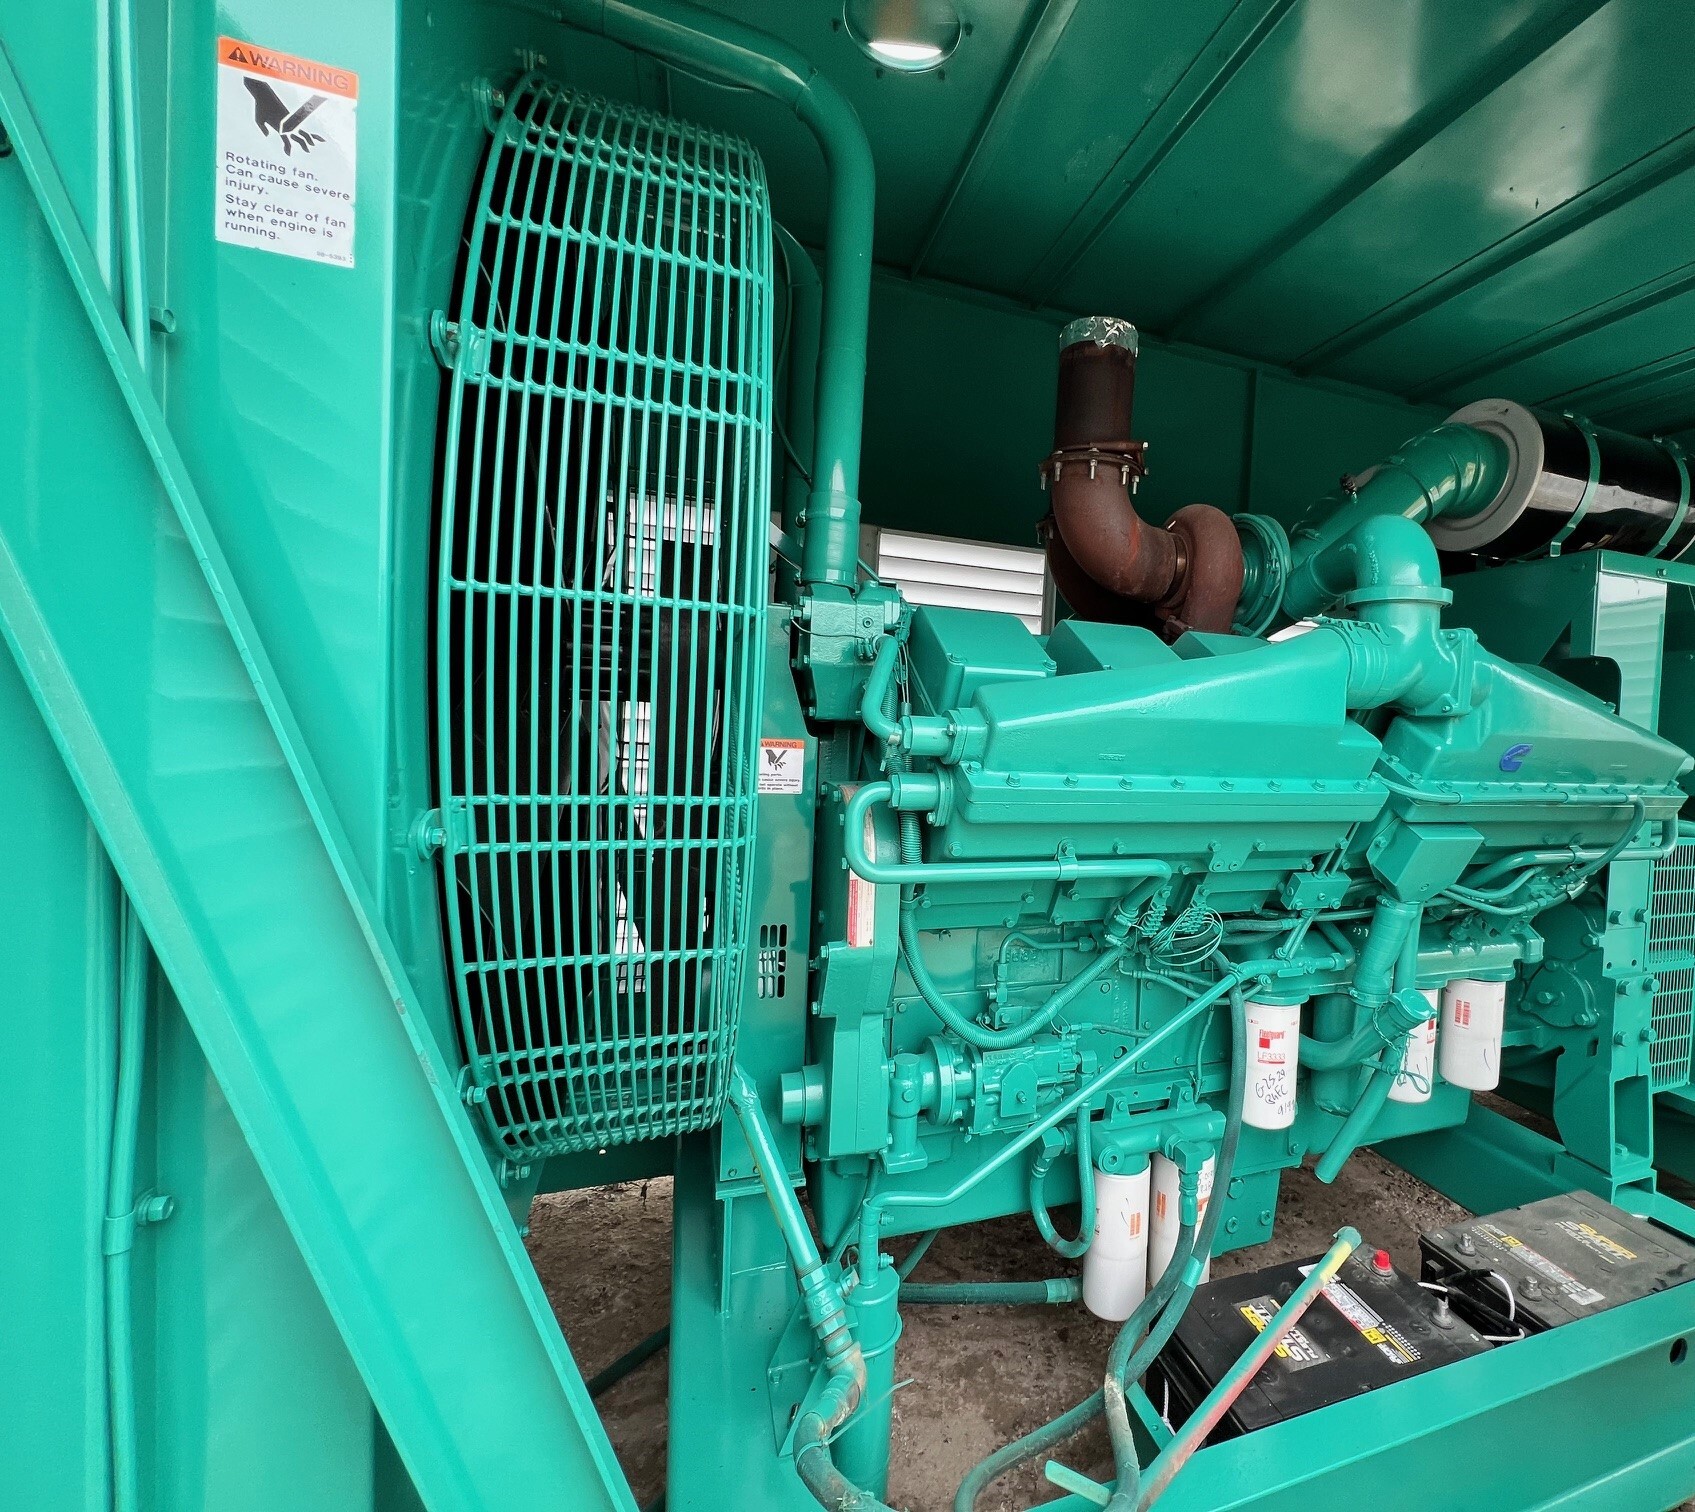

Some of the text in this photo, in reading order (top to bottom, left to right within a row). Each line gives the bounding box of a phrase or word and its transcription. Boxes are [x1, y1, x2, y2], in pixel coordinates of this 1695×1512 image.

[249, 50, 349, 90] WARNING
[225, 151, 319, 181] Rotating fan.
[225, 164, 350, 200] Can cause severe
[225, 177, 269, 195] injury.
[225, 193, 346, 228] Stay clear of fan
[225, 208, 333, 238] when engine is
[225, 221, 281, 240] running.
[764, 740, 797, 749] WARNING
[1259, 1028, 1286, 1041] Fleetguard
[1257, 1051, 1286, 1061] LF3333
